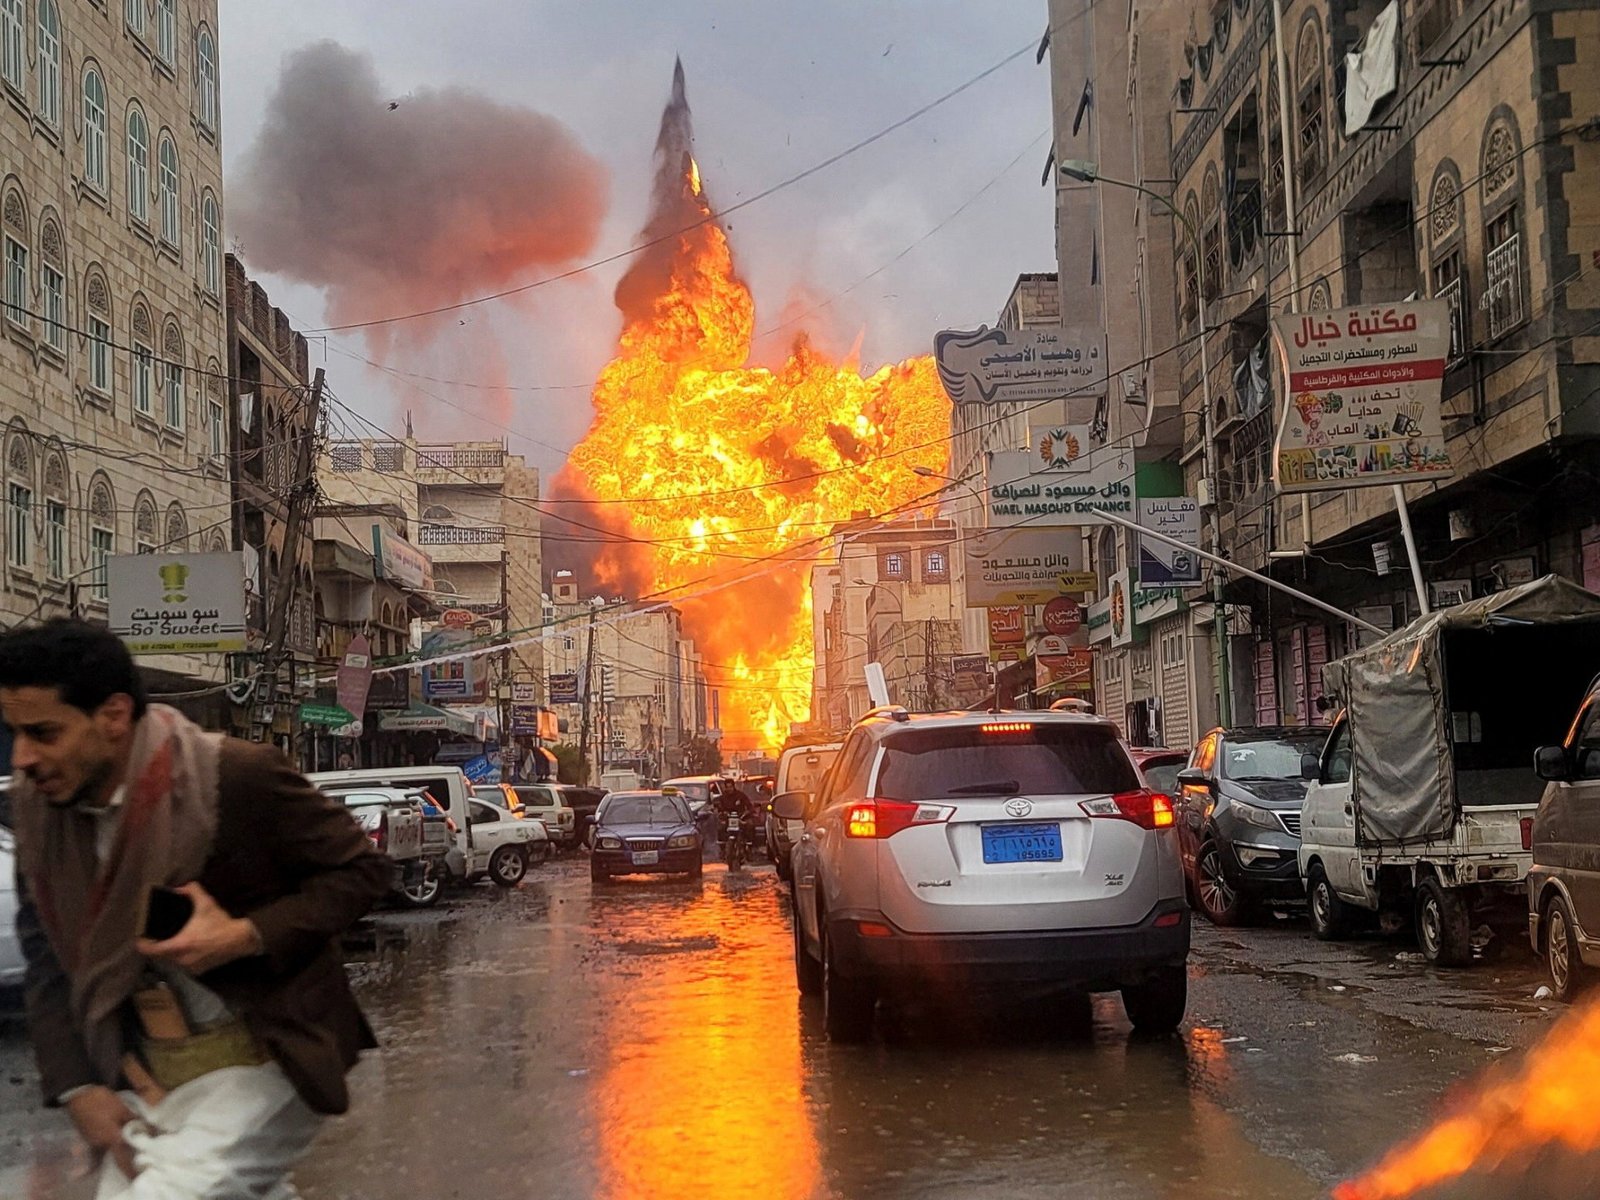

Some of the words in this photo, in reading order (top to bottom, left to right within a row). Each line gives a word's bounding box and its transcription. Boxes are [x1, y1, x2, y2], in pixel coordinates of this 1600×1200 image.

[1294, 314, 1342, 348] خيال
[1348, 308, 1416, 342] مكتبة
[1036, 332, 1058, 344] عيادة
[980, 344, 1036, 370] الأصبحي
[1040, 346, 1082, 362] وهيب
[1334, 348, 1384, 363] ومستحضرات
[1388, 344, 1418, 358] للعطور
[1300, 352, 1330, 366] التجميل
[1304, 374, 1347, 387] والقرطاسية
[1348, 370, 1380, 382] المكتبية
[1370, 388, 1400, 400] تحف
[1348, 406, 1382, 418] هدايا
[1327, 422, 1358, 438] العاب
[992, 484, 1040, 500] للصرافة
[1045, 486, 1096, 498] مسعود
[1100, 482, 1130, 498] وائل
[992, 504, 1022, 516] WAEL
[1024, 502, 1072, 514] MASOUD
[1074, 500, 1132, 514] EXCHANGE
[1148, 501, 1196, 515] مغاسل
[1158, 514, 1185, 526] الخير
[982, 557, 1040, 570] مسعود
[984, 571, 1030, 582] والتحويلات
[131, 608, 187, 625] سويت
[192, 608, 218, 624] سو
[130, 622, 154, 636] So
[160, 622, 220, 636] Sweet
